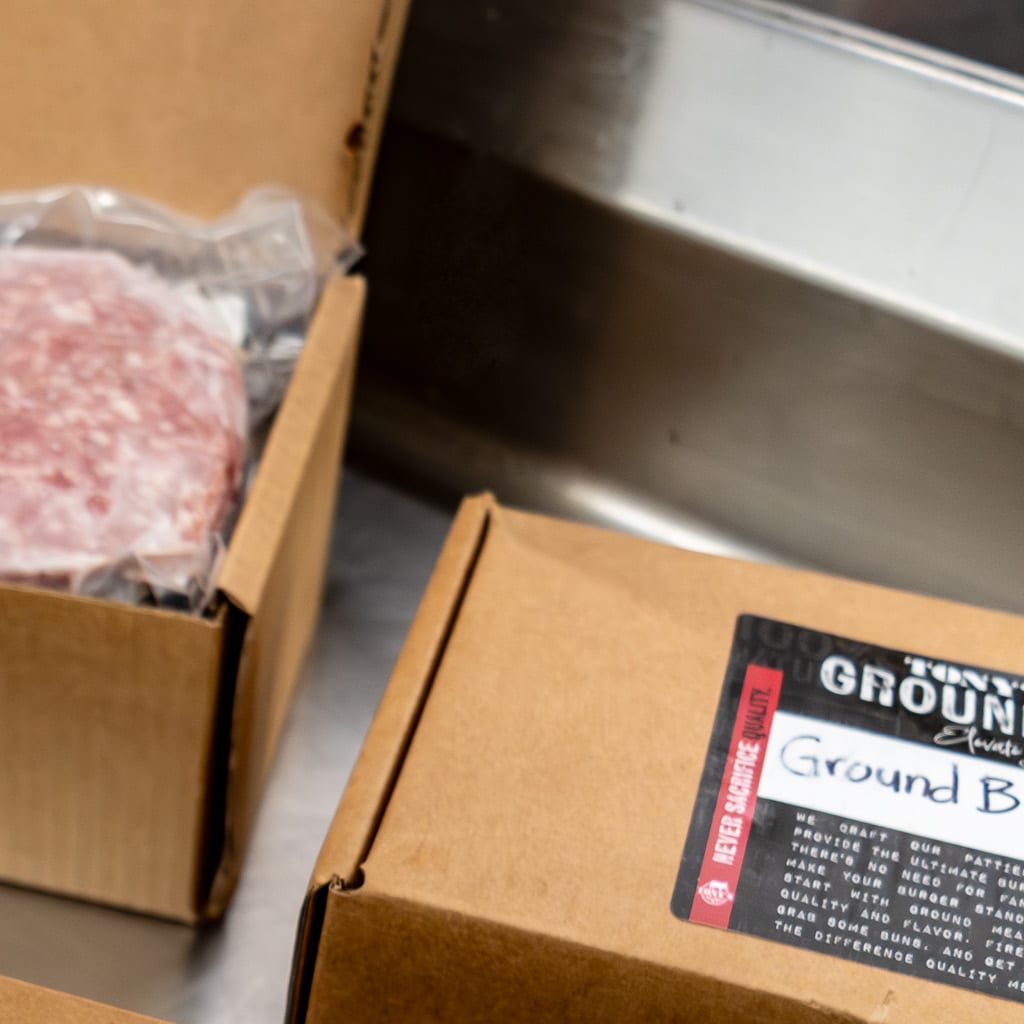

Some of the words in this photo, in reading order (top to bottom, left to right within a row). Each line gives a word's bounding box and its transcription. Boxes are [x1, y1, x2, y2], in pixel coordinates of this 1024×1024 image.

[820, 654, 1024, 738] GROUN
[903, 656, 1024, 698] TONY'
[724, 741, 760, 814] SACRIFICE
[781, 735, 959, 805] Ground
[712, 815, 743, 865] NEVER
[793, 826, 861, 853] PROVIDE
[871, 845, 900, 862] THE
[910, 855, 988, 884] ULTIMATE
[796, 812, 816, 826] WE
[839, 822, 888, 842] CRAFT
[910, 840, 941, 856] OUR
[964, 853, 1024, 877] PATTIE
[786, 858, 826, 876] MAKE
[843, 871, 883, 889] YOUR
[897, 885, 960, 908] BURGER
[791, 842, 854, 867] THERE'S
[867, 860, 888, 875] NO
[901, 869, 942, 888] NEED
[955, 882, 986, 898] FOR
[780, 888, 849, 913] QUALITY
[860, 908, 891, 924] AND
[903, 919, 969, 944] FLAVOR.
[783, 872, 832, 892] START
[850, 889, 890, 907] WITH
[909, 904, 972, 928] GROUND
[774, 920, 803, 937] THE
[814, 930, 914, 964] DIFFERENCE
[925, 958, 997, 984] QUALITY
[776, 904, 816, 923] GRAB
[827, 916, 869, 937] SOME
[942, 946, 973, 962] AND
[984, 956, 1015, 971] GET
